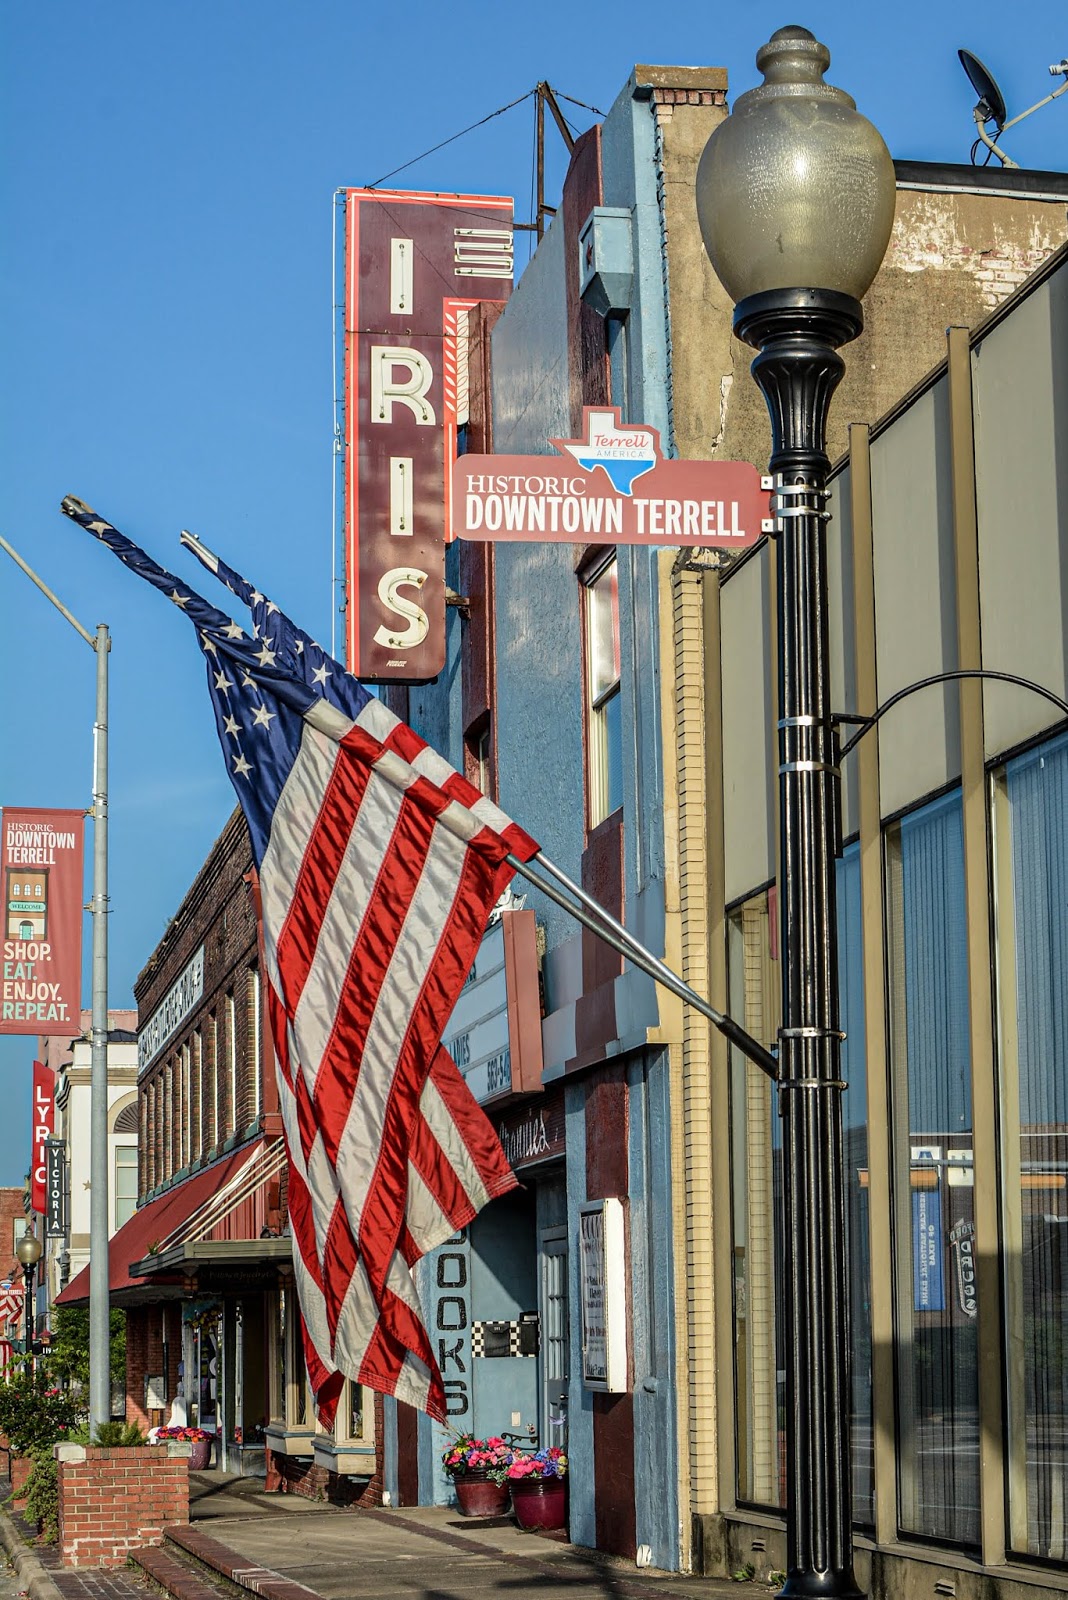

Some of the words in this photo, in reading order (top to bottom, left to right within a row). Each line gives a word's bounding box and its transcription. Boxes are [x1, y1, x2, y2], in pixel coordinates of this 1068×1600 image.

[371, 238, 436, 649] IRIS
[594, 430, 649, 448] Terrell
[596, 450, 644, 458] AMERICA
[466, 475, 586, 496] HISTORIC
[466, 494, 623, 533] DOWNTOWN
[633, 499, 745, 536] TERRELL
[7, 822, 54, 832] HISTORIC
[7, 831, 75, 849] DOWNTOWN
[7, 847, 56, 865] TERRELL
[4, 941, 51, 961] SHOP.
[4, 961, 38, 981] EAT.
[3, 981, 62, 1002] ENJOY.
[2, 1001, 70, 1022] REPEAT.
[35, 1085, 51, 1184] LYRIC
[52, 1149, 60, 1229] VICTORIA
